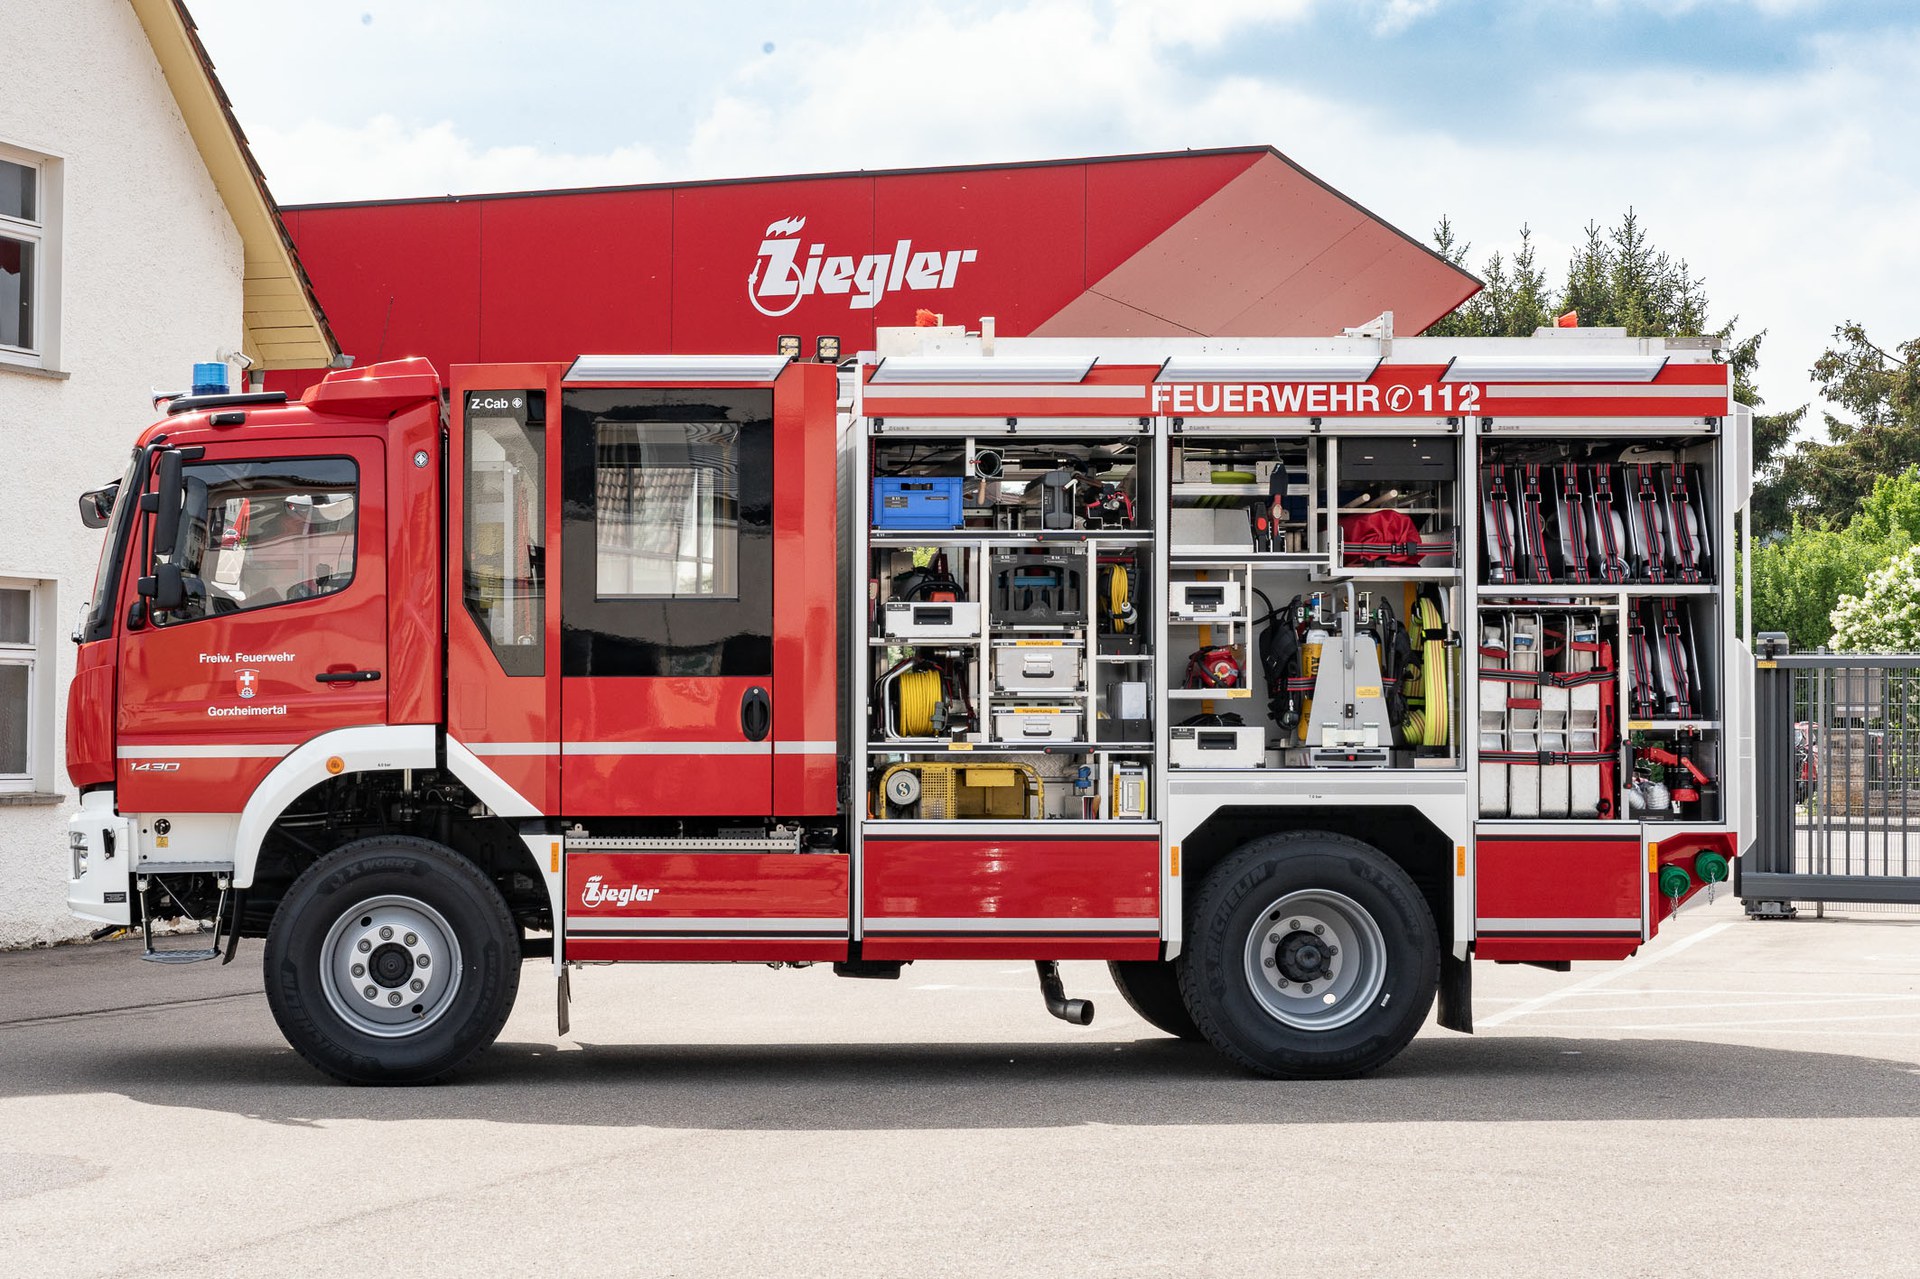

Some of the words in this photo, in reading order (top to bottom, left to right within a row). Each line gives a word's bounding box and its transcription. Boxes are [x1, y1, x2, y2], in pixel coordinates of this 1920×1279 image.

[750, 228, 977, 312] Ziegler
[471, 398, 509, 409] Z-Cab
[1151, 384, 1380, 412] FEUERWEHR
[1417, 384, 1481, 412] 112
[199, 653, 233, 664] Freiw.
[235, 652, 296, 663] Feuerwehr
[207, 704, 288, 717] Gorxheimertal
[130, 762, 181, 772] 1430
[362, 858, 417, 871] WORKS
[582, 878, 660, 907] Ziegler
[1206, 864, 1268, 960] MICHELIN
